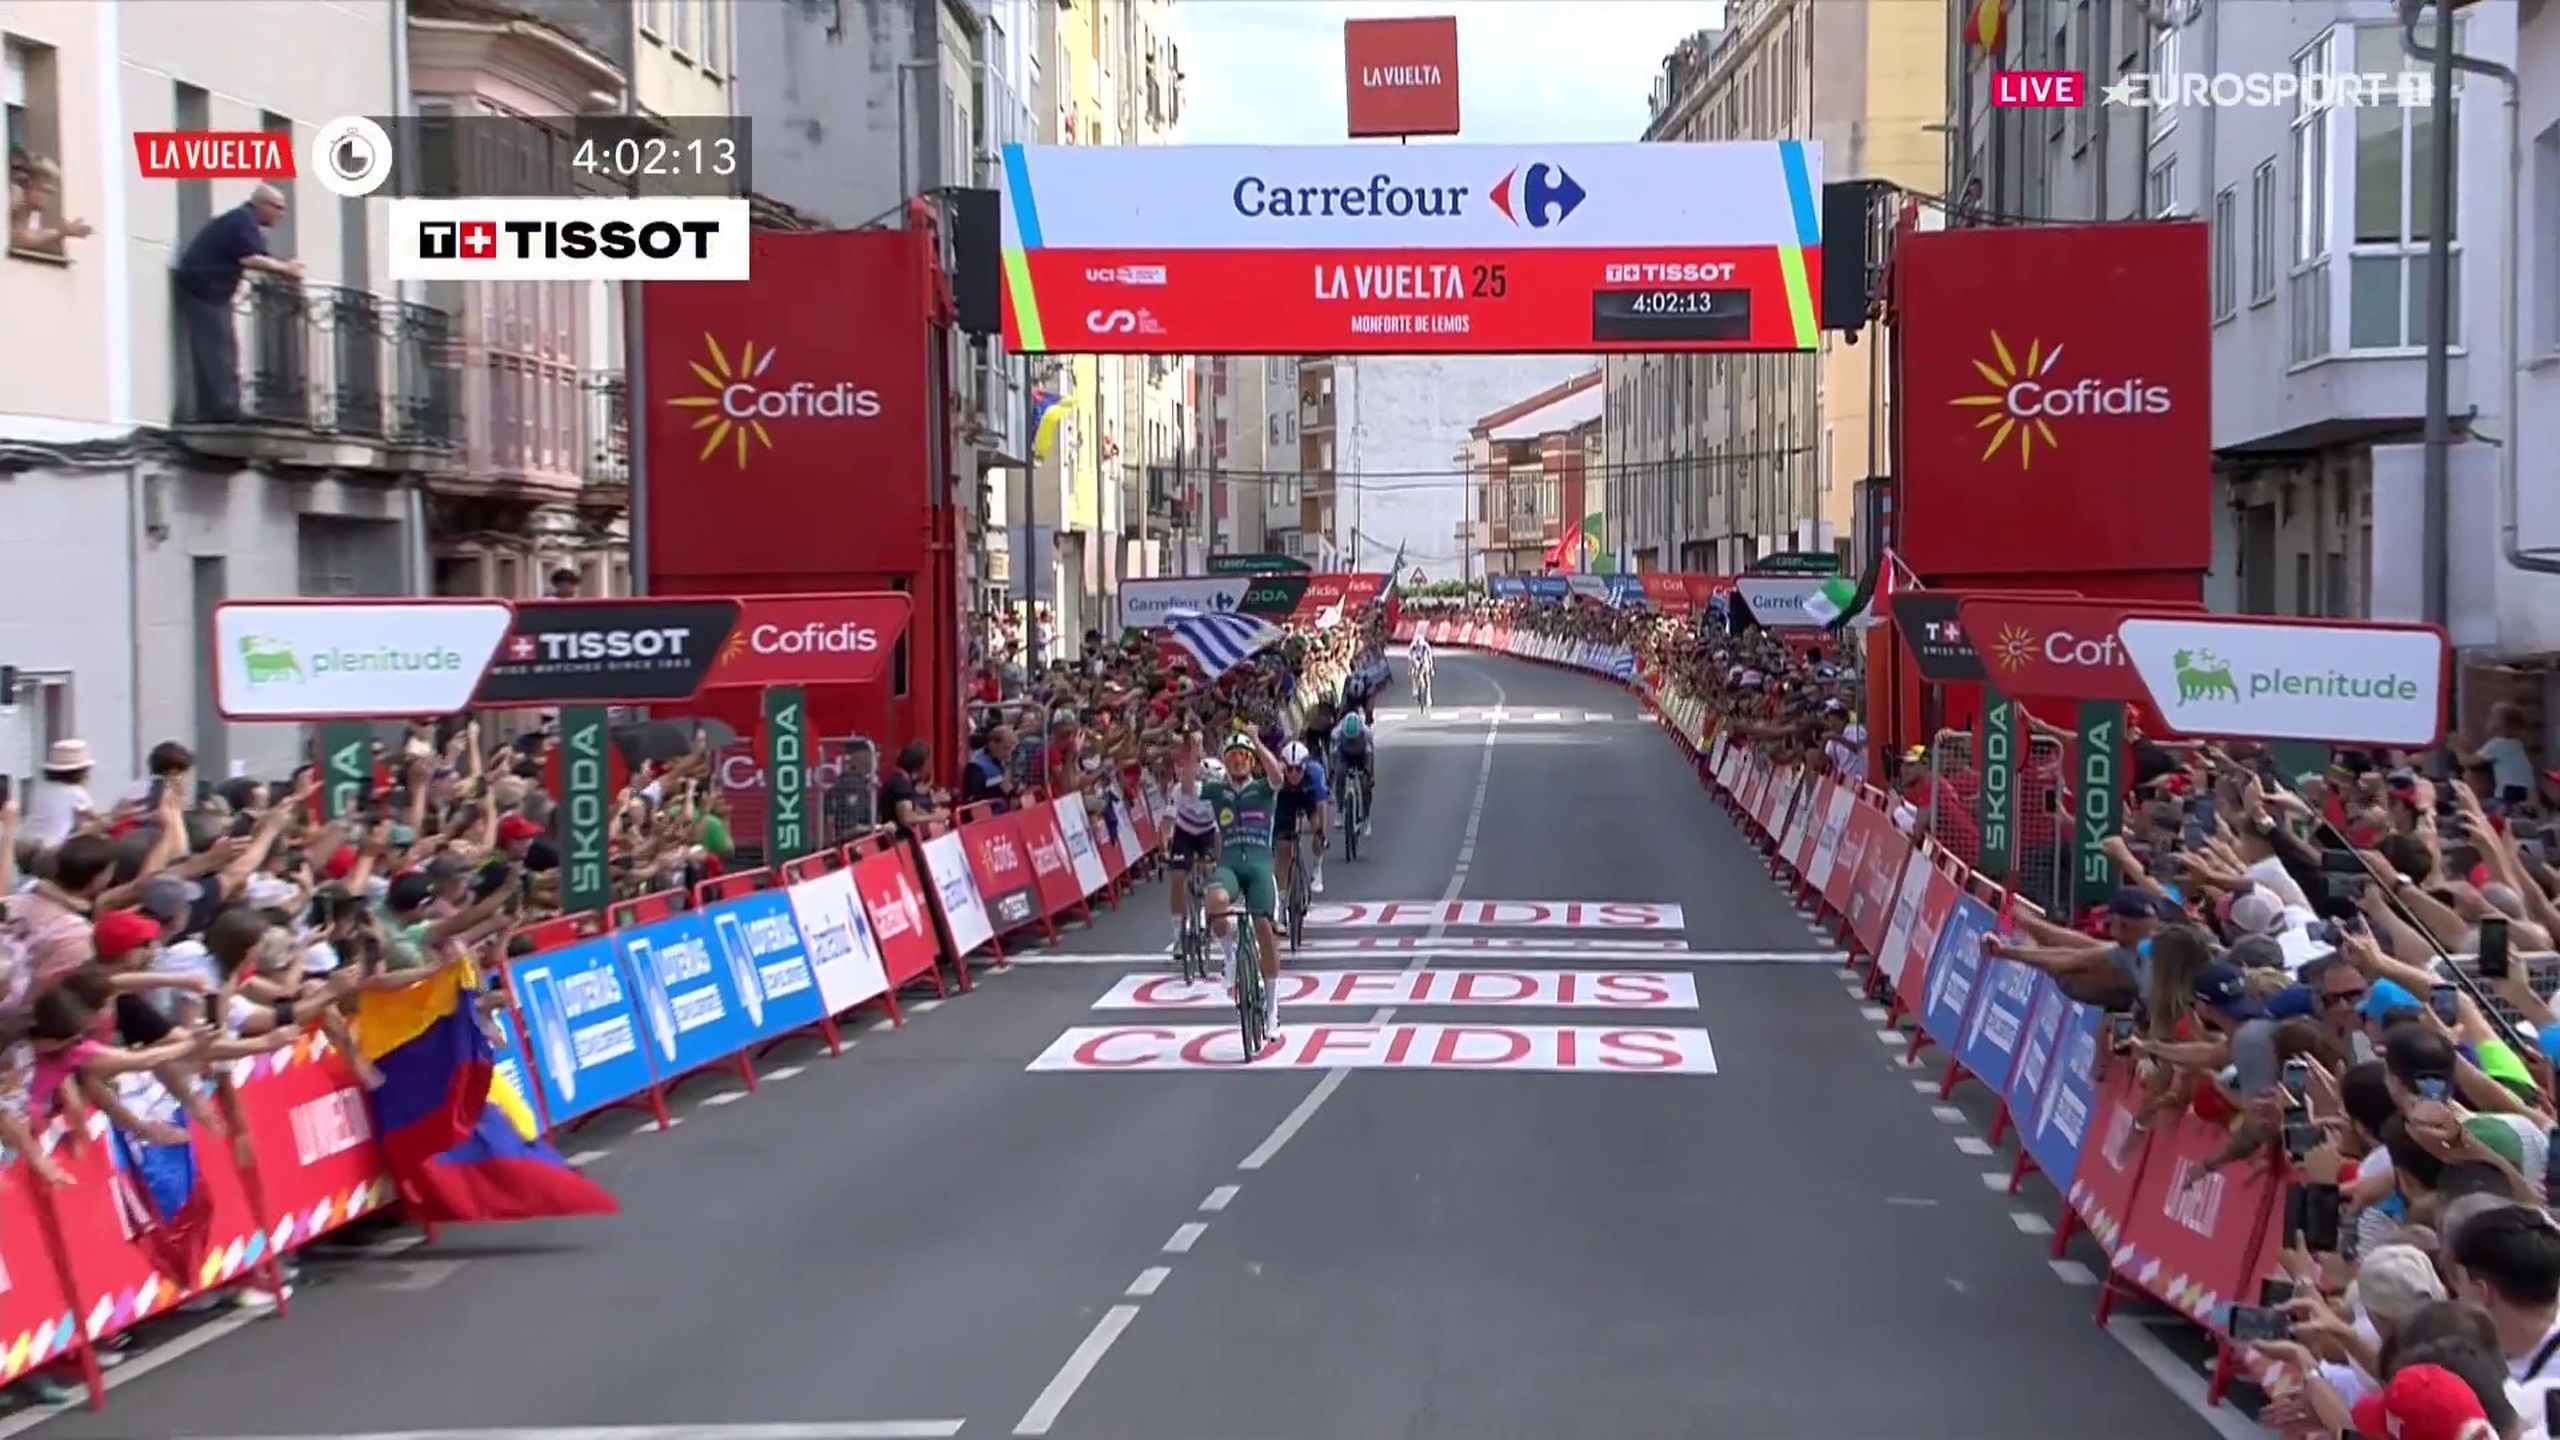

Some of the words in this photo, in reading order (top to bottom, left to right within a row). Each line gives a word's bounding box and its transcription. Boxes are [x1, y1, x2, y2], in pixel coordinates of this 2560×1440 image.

[1363, 66, 1382, 87] LA
[1384, 65, 1441, 86] VUELTA
[1233, 174, 1468, 217] Carrefour
[1085, 268, 1114, 282] UCI
[1314, 265, 1349, 299] LA
[1354, 265, 1465, 299] VUELTA
[1472, 264, 1507, 298] 25
[1642, 262, 1736, 282] TISSOT
[1632, 291, 1712, 313] 4:02:13
[1351, 315, 1412, 333] MONFORTE
[1415, 315, 1430, 333] DE
[1432, 315, 1470, 333] LEMOS
[722, 381, 881, 418] Cofidis
[2007, 377, 2172, 416] Cofidis
[539, 628, 689, 660] TISSOT
[751, 621, 878, 656] Cofidis
[311, 645, 462, 677] plenitude
[2250, 668, 2418, 701] plenitude
[1072, 1025, 1685, 1068] COFIDIS
